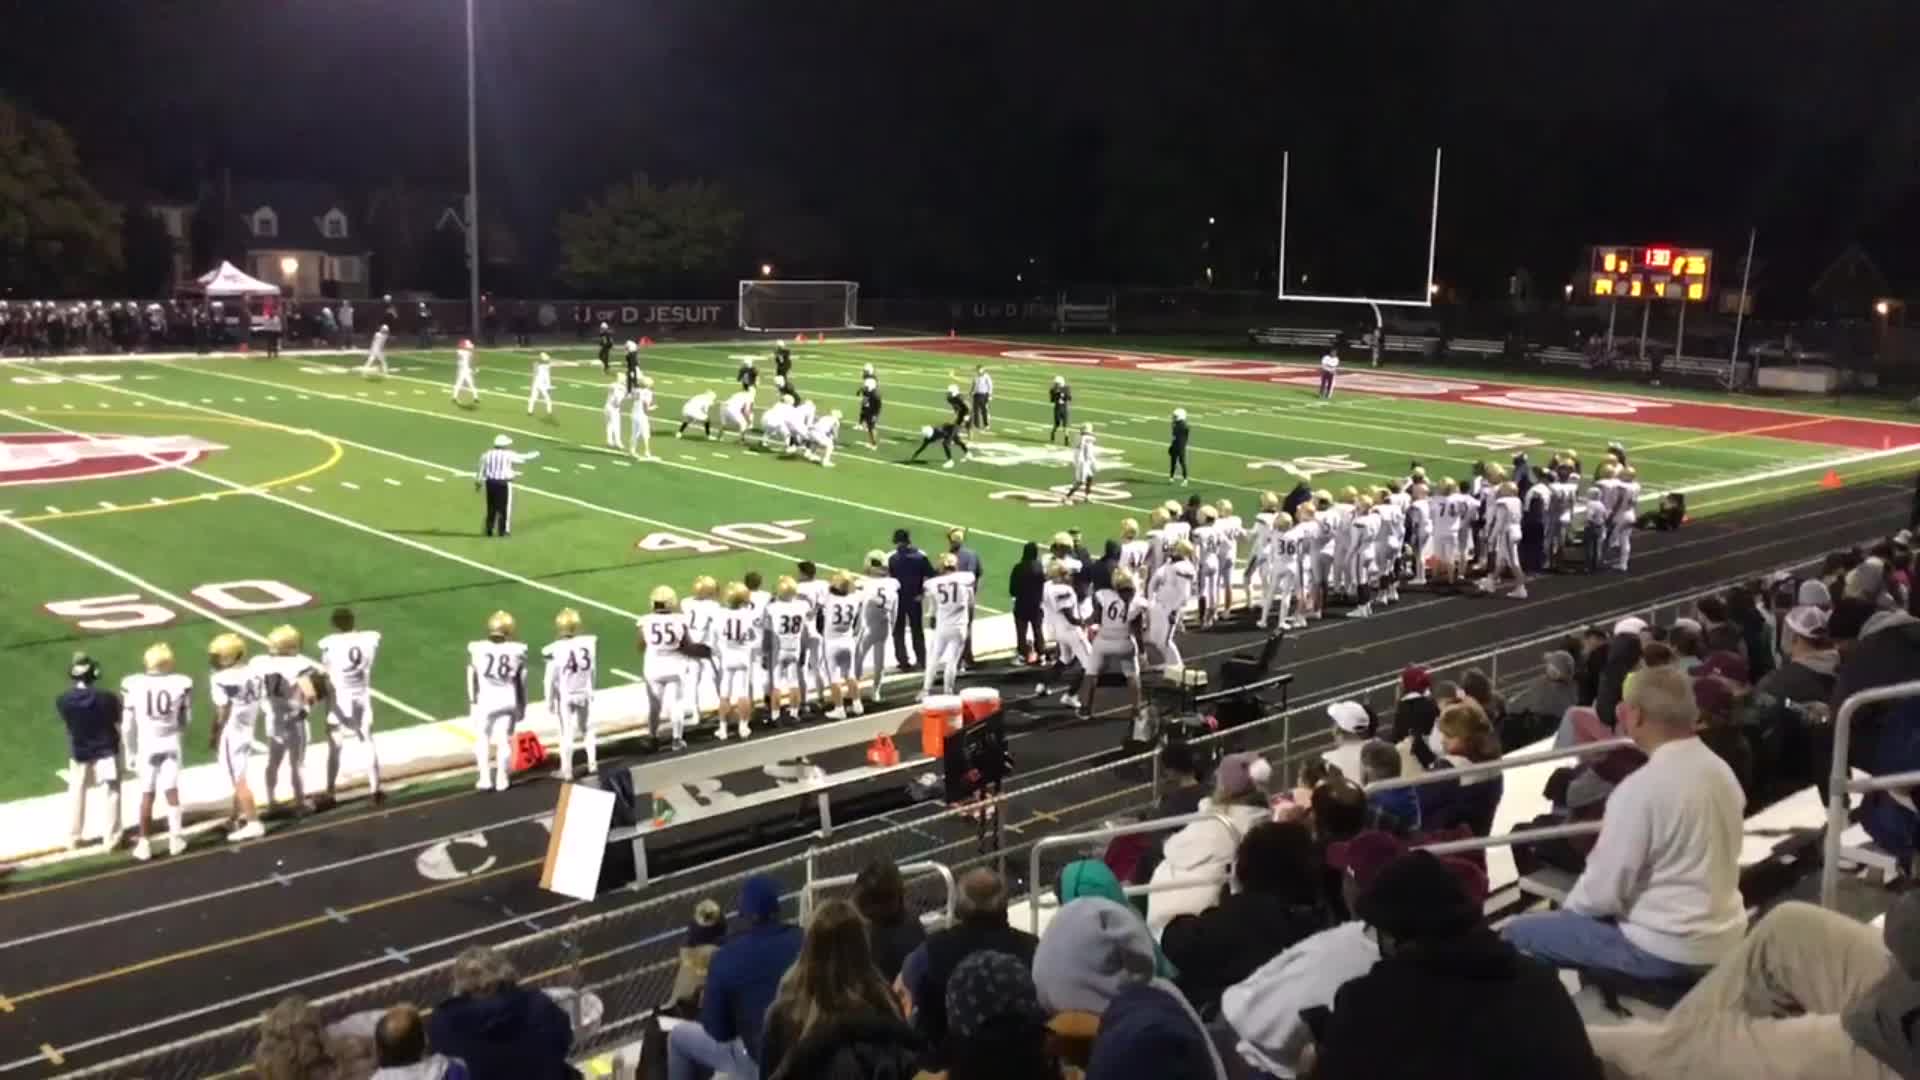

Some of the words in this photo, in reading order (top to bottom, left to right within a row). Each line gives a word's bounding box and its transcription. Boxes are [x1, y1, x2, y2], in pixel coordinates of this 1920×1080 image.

[621, 305, 639, 323] D
[645, 305, 721, 323] JESUIT
[637, 522, 808, 553] 40
[44, 579, 313, 629] 50
[937, 581, 959, 604] 57
[779, 615, 801, 635] 38
[832, 603, 855, 625] 33
[651, 622, 676, 645] 55
[723, 617, 742, 641] 41
[349, 646, 362, 672] 9
[483, 653, 511, 679] 28
[562, 647, 591, 674] 43
[146, 690, 173, 717] 10
